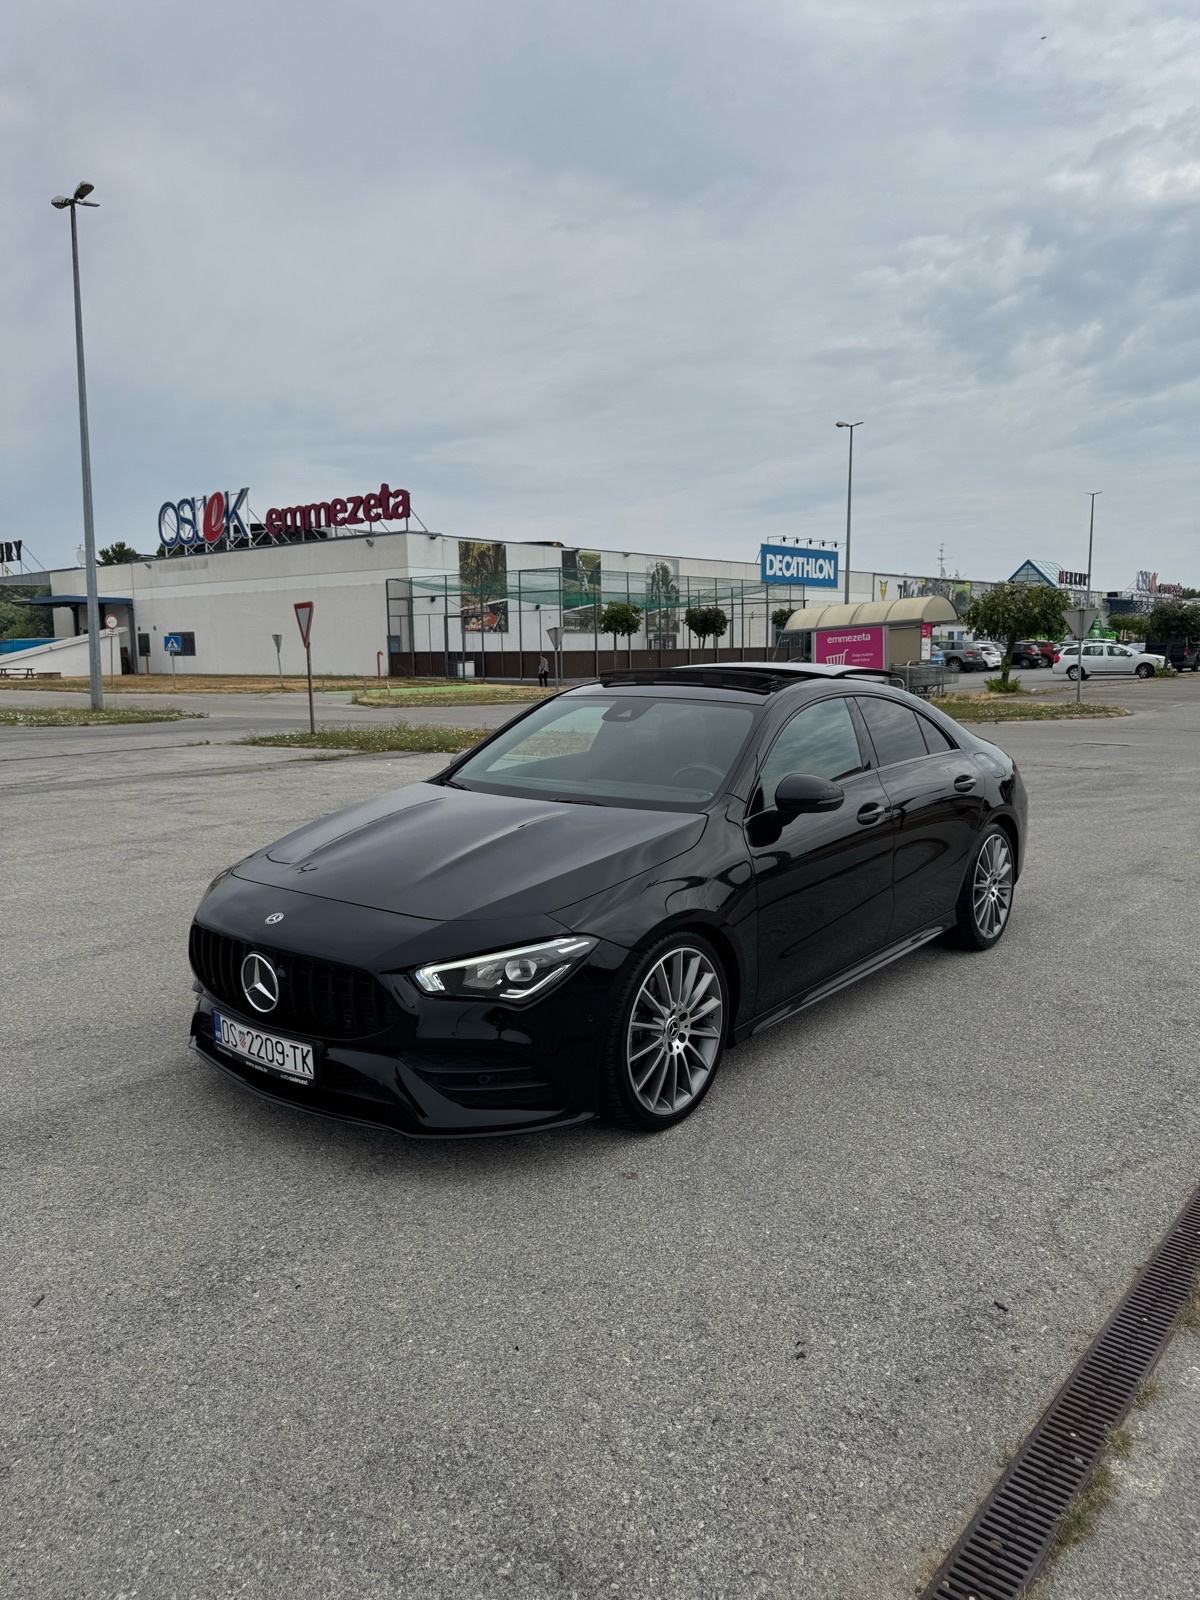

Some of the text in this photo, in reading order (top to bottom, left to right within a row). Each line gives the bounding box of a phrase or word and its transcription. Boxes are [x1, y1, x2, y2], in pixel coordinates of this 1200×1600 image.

[265, 482, 411, 535] emmezeta
[765, 553, 835, 580] DECATHLON
[826, 633, 871, 644] emmezeta
[221, 1019, 238, 1048] OS
